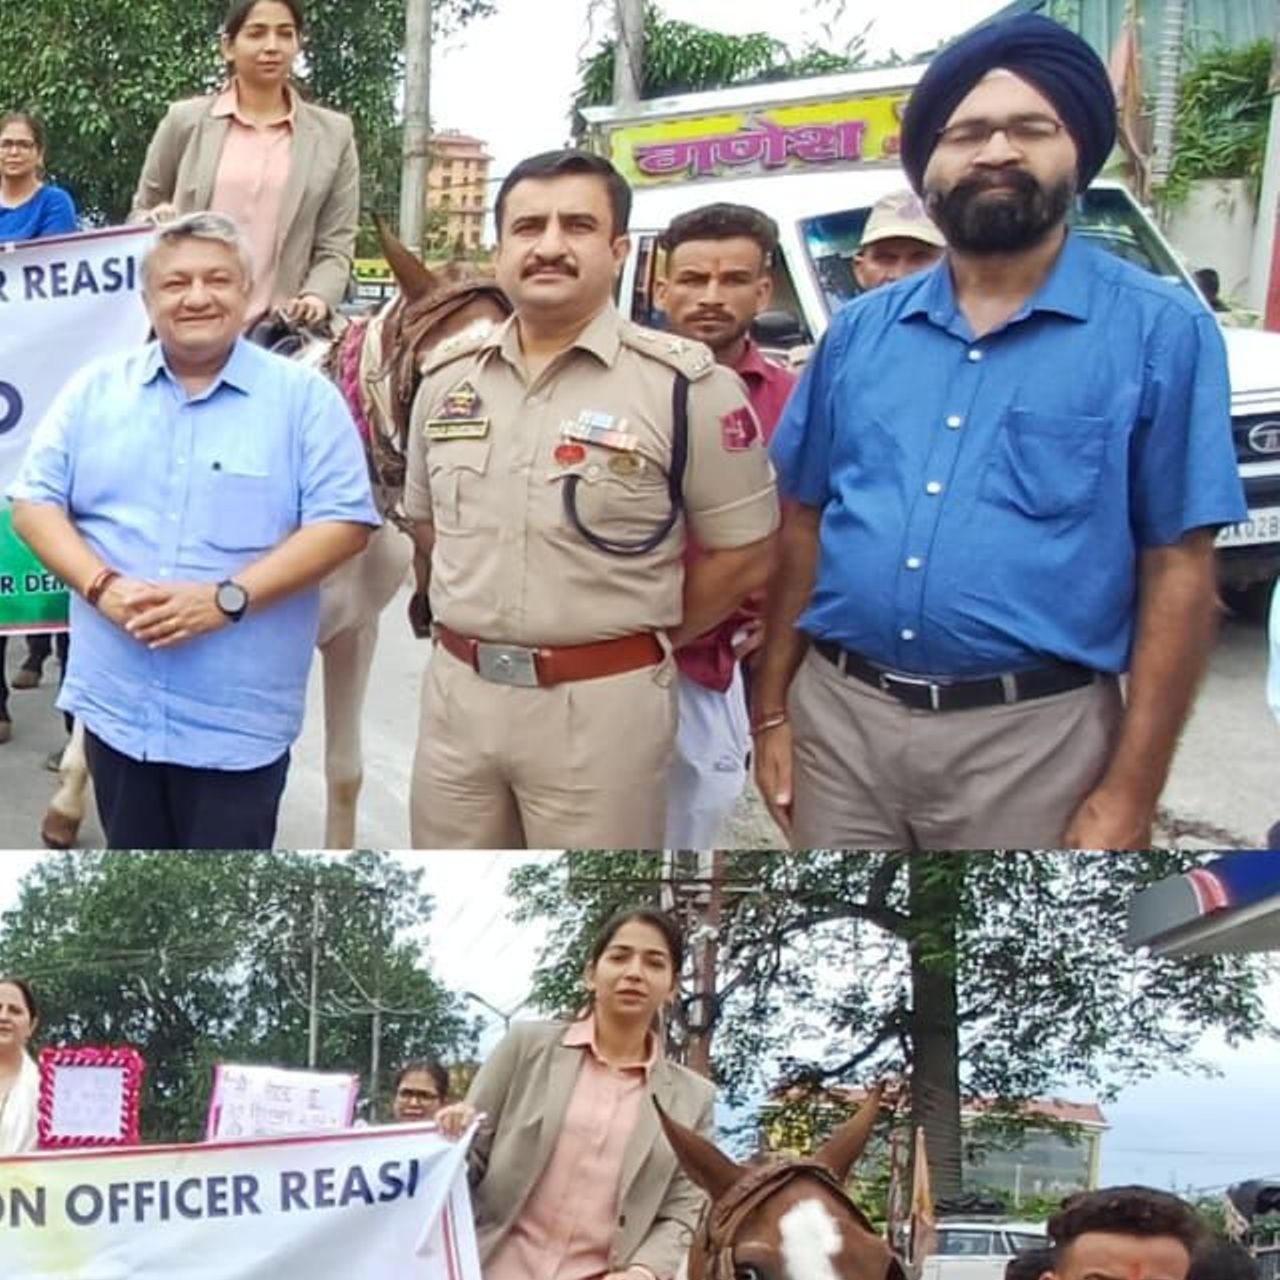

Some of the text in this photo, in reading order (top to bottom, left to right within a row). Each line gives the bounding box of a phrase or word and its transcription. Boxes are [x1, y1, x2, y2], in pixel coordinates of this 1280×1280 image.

[635, 115, 865, 174] गणेश
[23, 255, 137, 298] REASI
[65, 1175, 262, 1225] OFFICER
[280, 1158, 419, 1213] REASI
